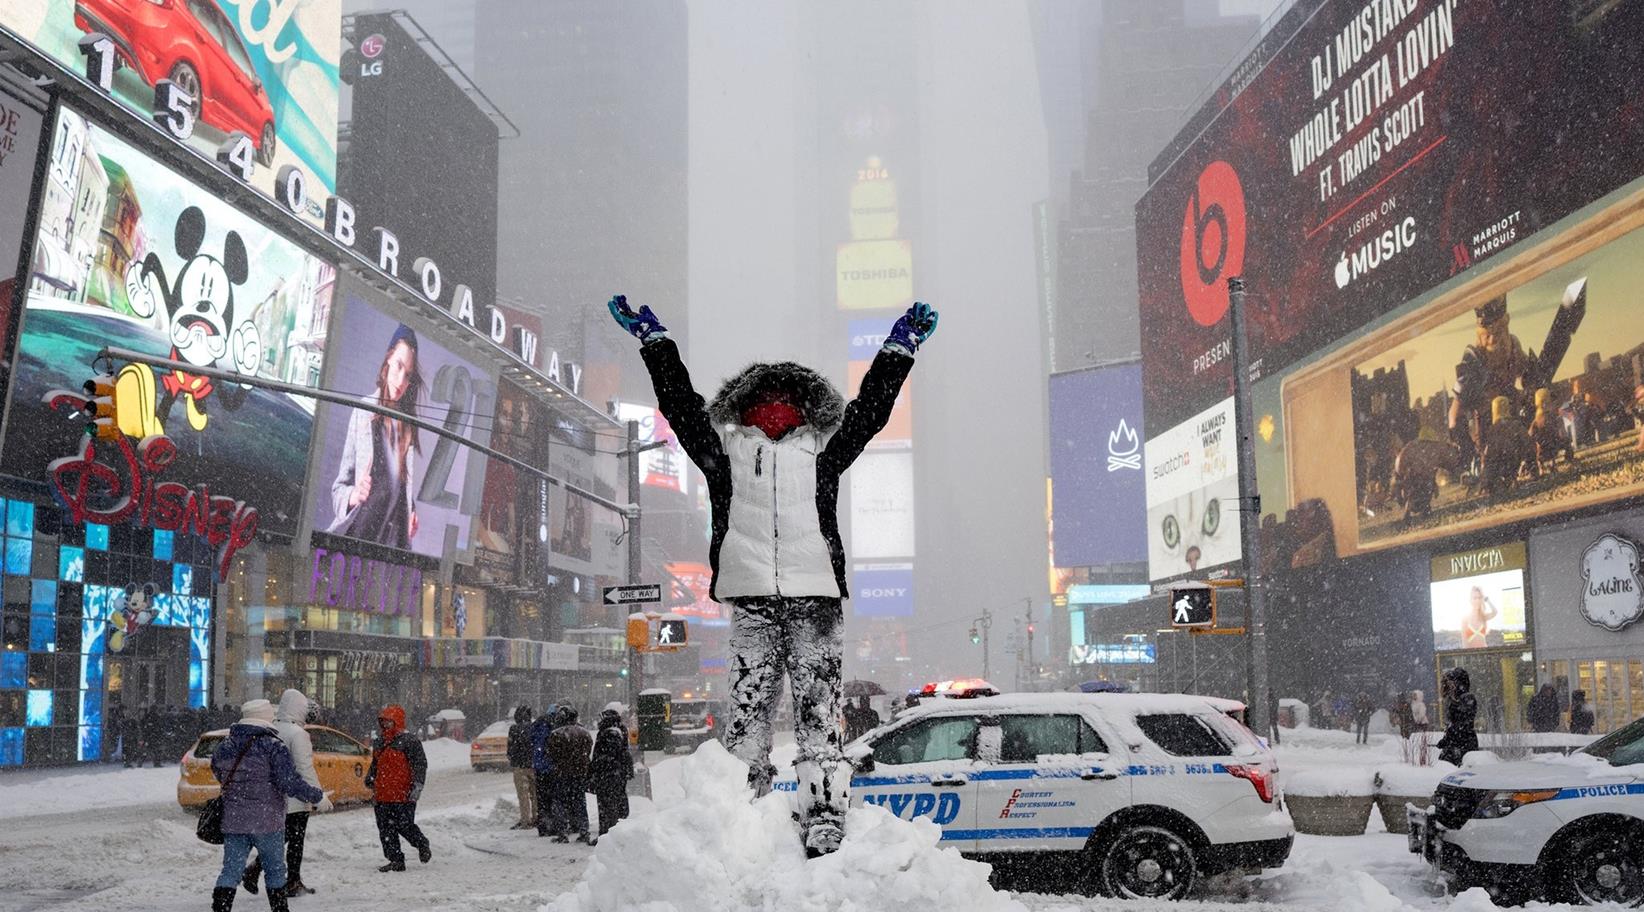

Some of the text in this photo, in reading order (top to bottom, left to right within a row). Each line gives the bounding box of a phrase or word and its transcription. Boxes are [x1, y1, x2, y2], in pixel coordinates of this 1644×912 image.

[361, 62, 382, 76] LG
[1312, 45, 1333, 99] DJ
[1290, 97, 1341, 176] WHOLE
[1344, 54, 1393, 132] LOTTA
[1320, 91, 1425, 201] FT. TRAVIS SCOTT
[82, 33, 582, 394] 1540 BROADWAY
[1348, 196, 1396, 238] LISTEN ON
[1473, 211, 1521, 245] MARRIOTT
[1351, 216, 1416, 280] MUSIC
[1474, 228, 1516, 259] MARQUIS
[841, 267, 908, 282] TOSHIBA
[1193, 337, 1231, 375] PRESEN
[1201, 411, 1226, 434] ALWAYS
[1202, 429, 1222, 448] WANT
[1153, 453, 1184, 480] swatch
[1451, 549, 1504, 575] INVICTA
[309, 547, 422, 617] FOREVER
[619, 588, 655, 599] ONE WAY
[860, 588, 907, 598] SONY
[1006, 798, 1076, 808] PROFESSIONALISM
[1580, 784, 1626, 798] POLICE
[999, 809, 1037, 819] RESPECT
